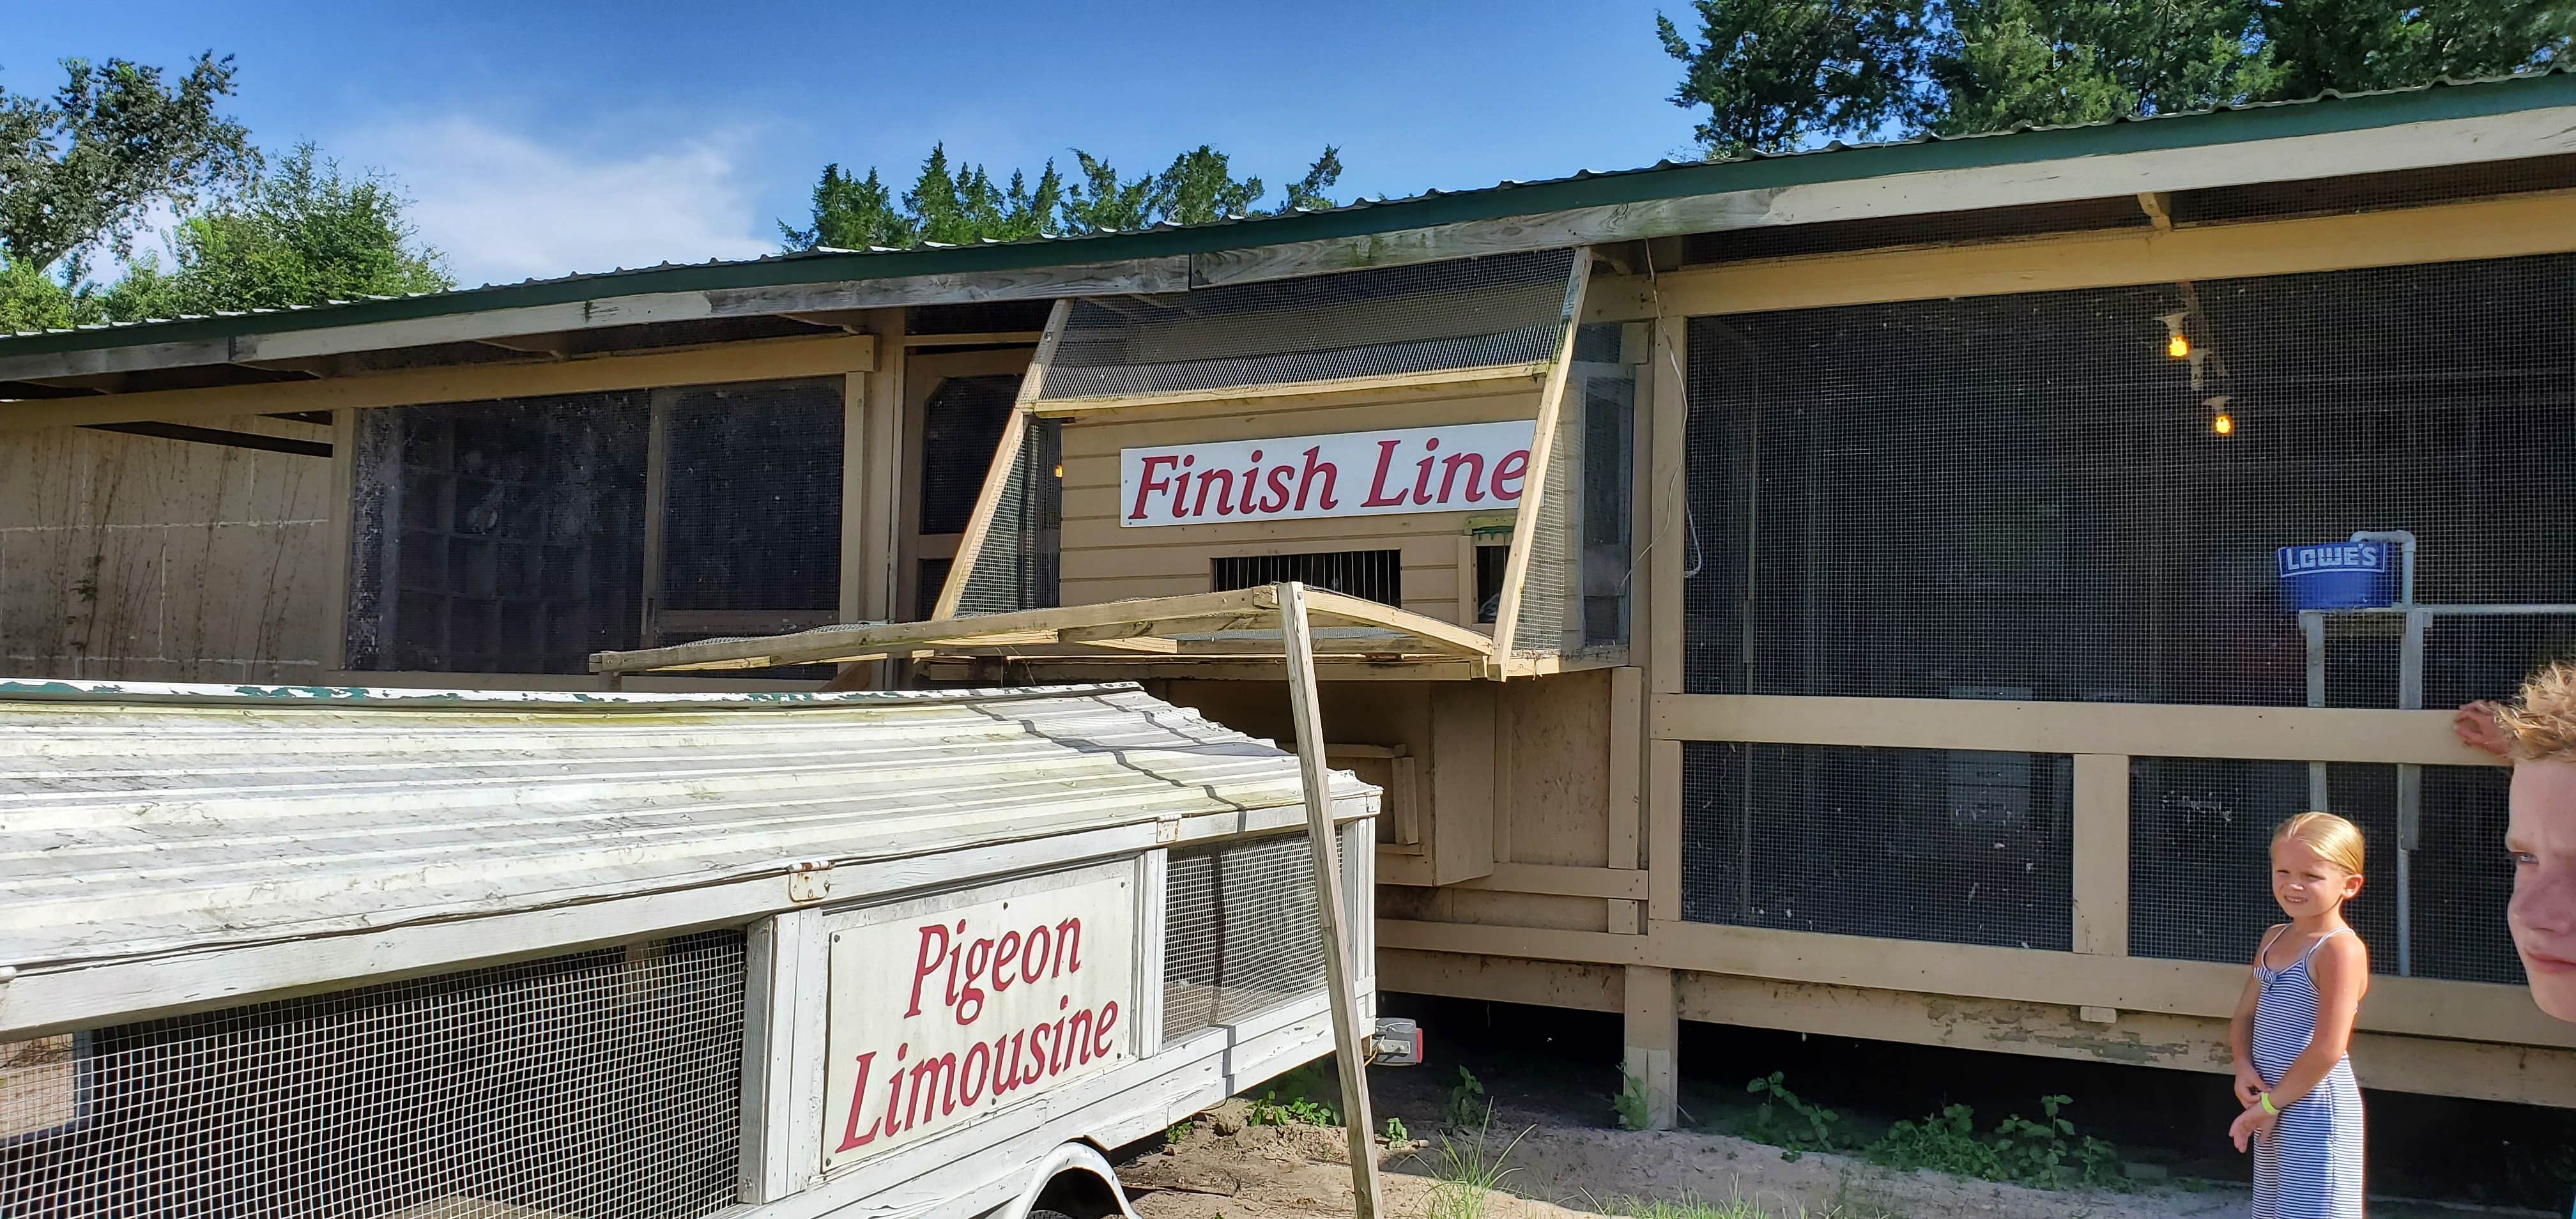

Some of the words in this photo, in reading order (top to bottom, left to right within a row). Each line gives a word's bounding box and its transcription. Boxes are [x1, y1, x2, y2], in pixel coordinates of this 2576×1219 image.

[1128, 446, 1339, 520] Finish
[1360, 437, 1531, 509] Line
[2286, 543, 2377, 571] LOWE'S
[904, 916, 1082, 1025] Pigeon
[835, 994, 1119, 1154] Limousine
